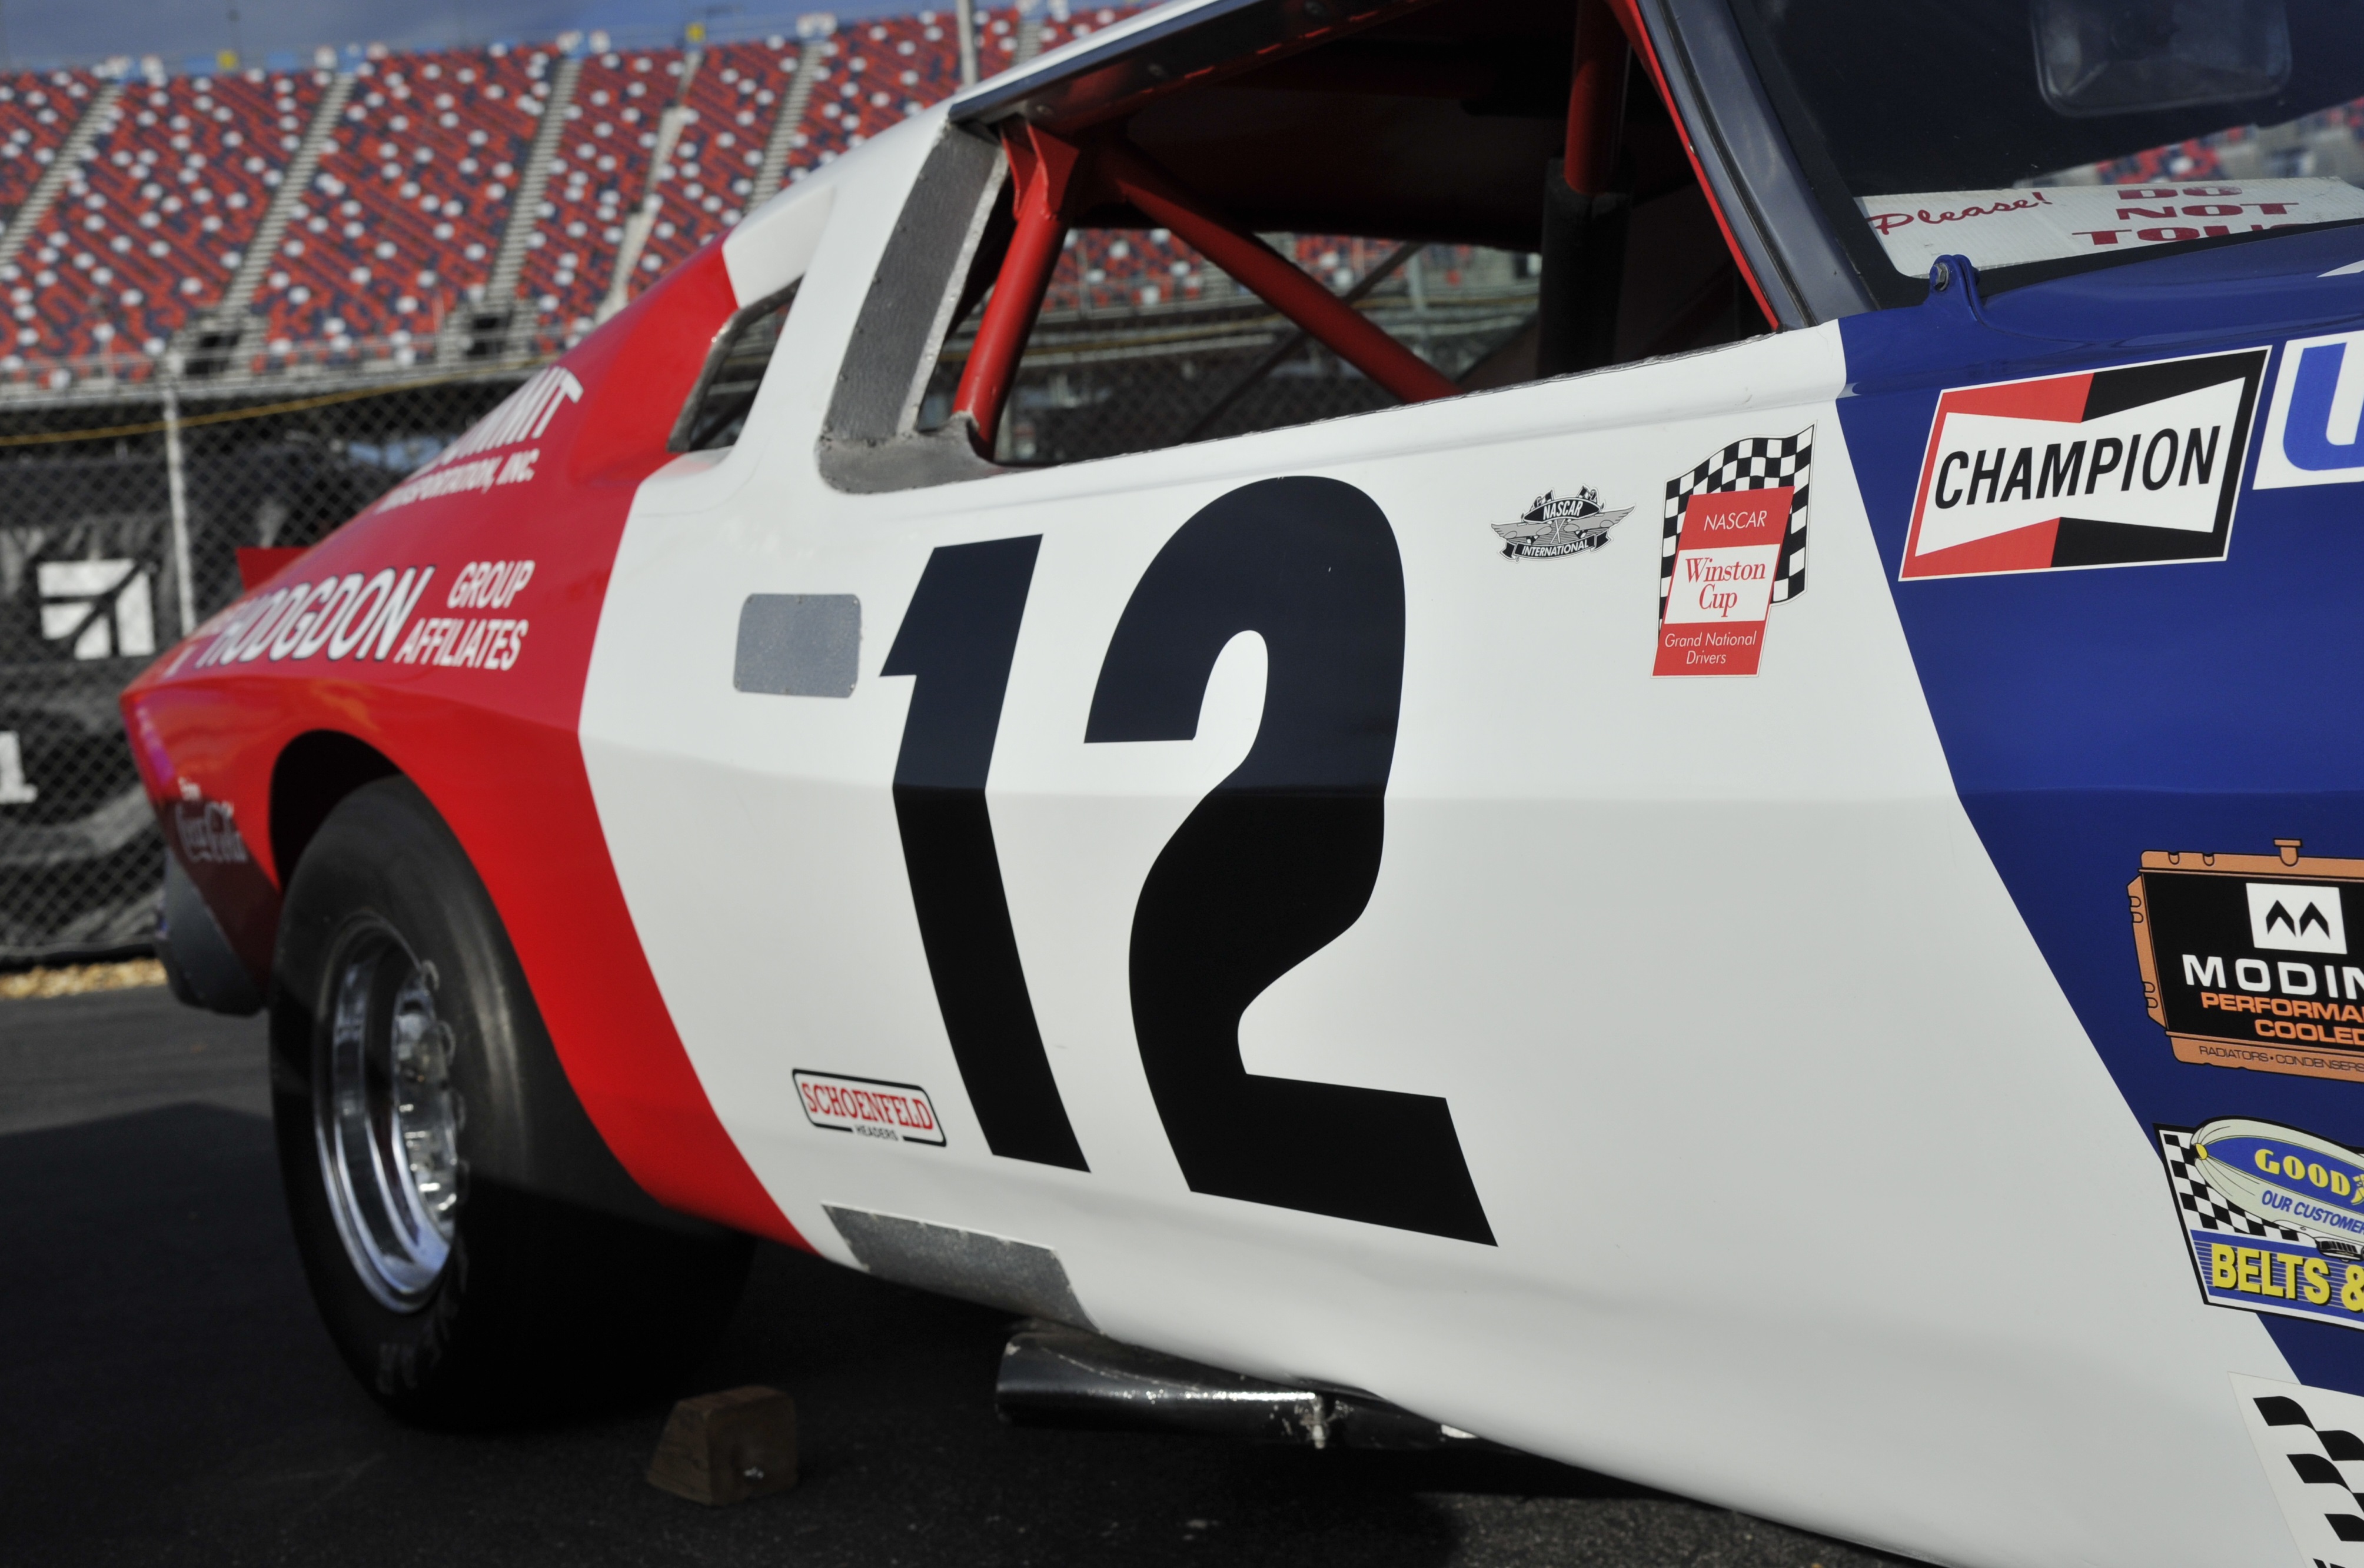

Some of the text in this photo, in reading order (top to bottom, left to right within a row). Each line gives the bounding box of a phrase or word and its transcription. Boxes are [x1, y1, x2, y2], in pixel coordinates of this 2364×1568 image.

[2117, 186, 2243, 200] DO
[1867, 192, 2052, 235] Please!
[2116, 202, 2299, 220] NOT
[1934, 425, 2221, 510] CHAMPION
[1543, 500, 1584, 521] NASCAR
[1703, 510, 1767, 531] NASCAR
[1521, 539, 1589, 557] INTERNATIONAL
[1685, 556, 1766, 584] Winston
[447, 560, 536, 610] GROUP
[1698, 583, 1738, 618] Cup
[394, 617, 529, 671] AFFILIATES
[1665, 630, 1757, 648] Grand National
[1686, 650, 1727, 664] Drivers
[879, 475, 1498, 1247] 12
[2200, 991, 2364, 1024] PERFORMA
[2199, 1045, 2269, 1063] RADIATORS
[802, 1082, 933, 1130] SCHOENFELD
[855, 1125, 899, 1141] HEADERS
[2262, 1190, 2294, 1213] OUR
[2211, 1243, 2332, 1307] BELTS
